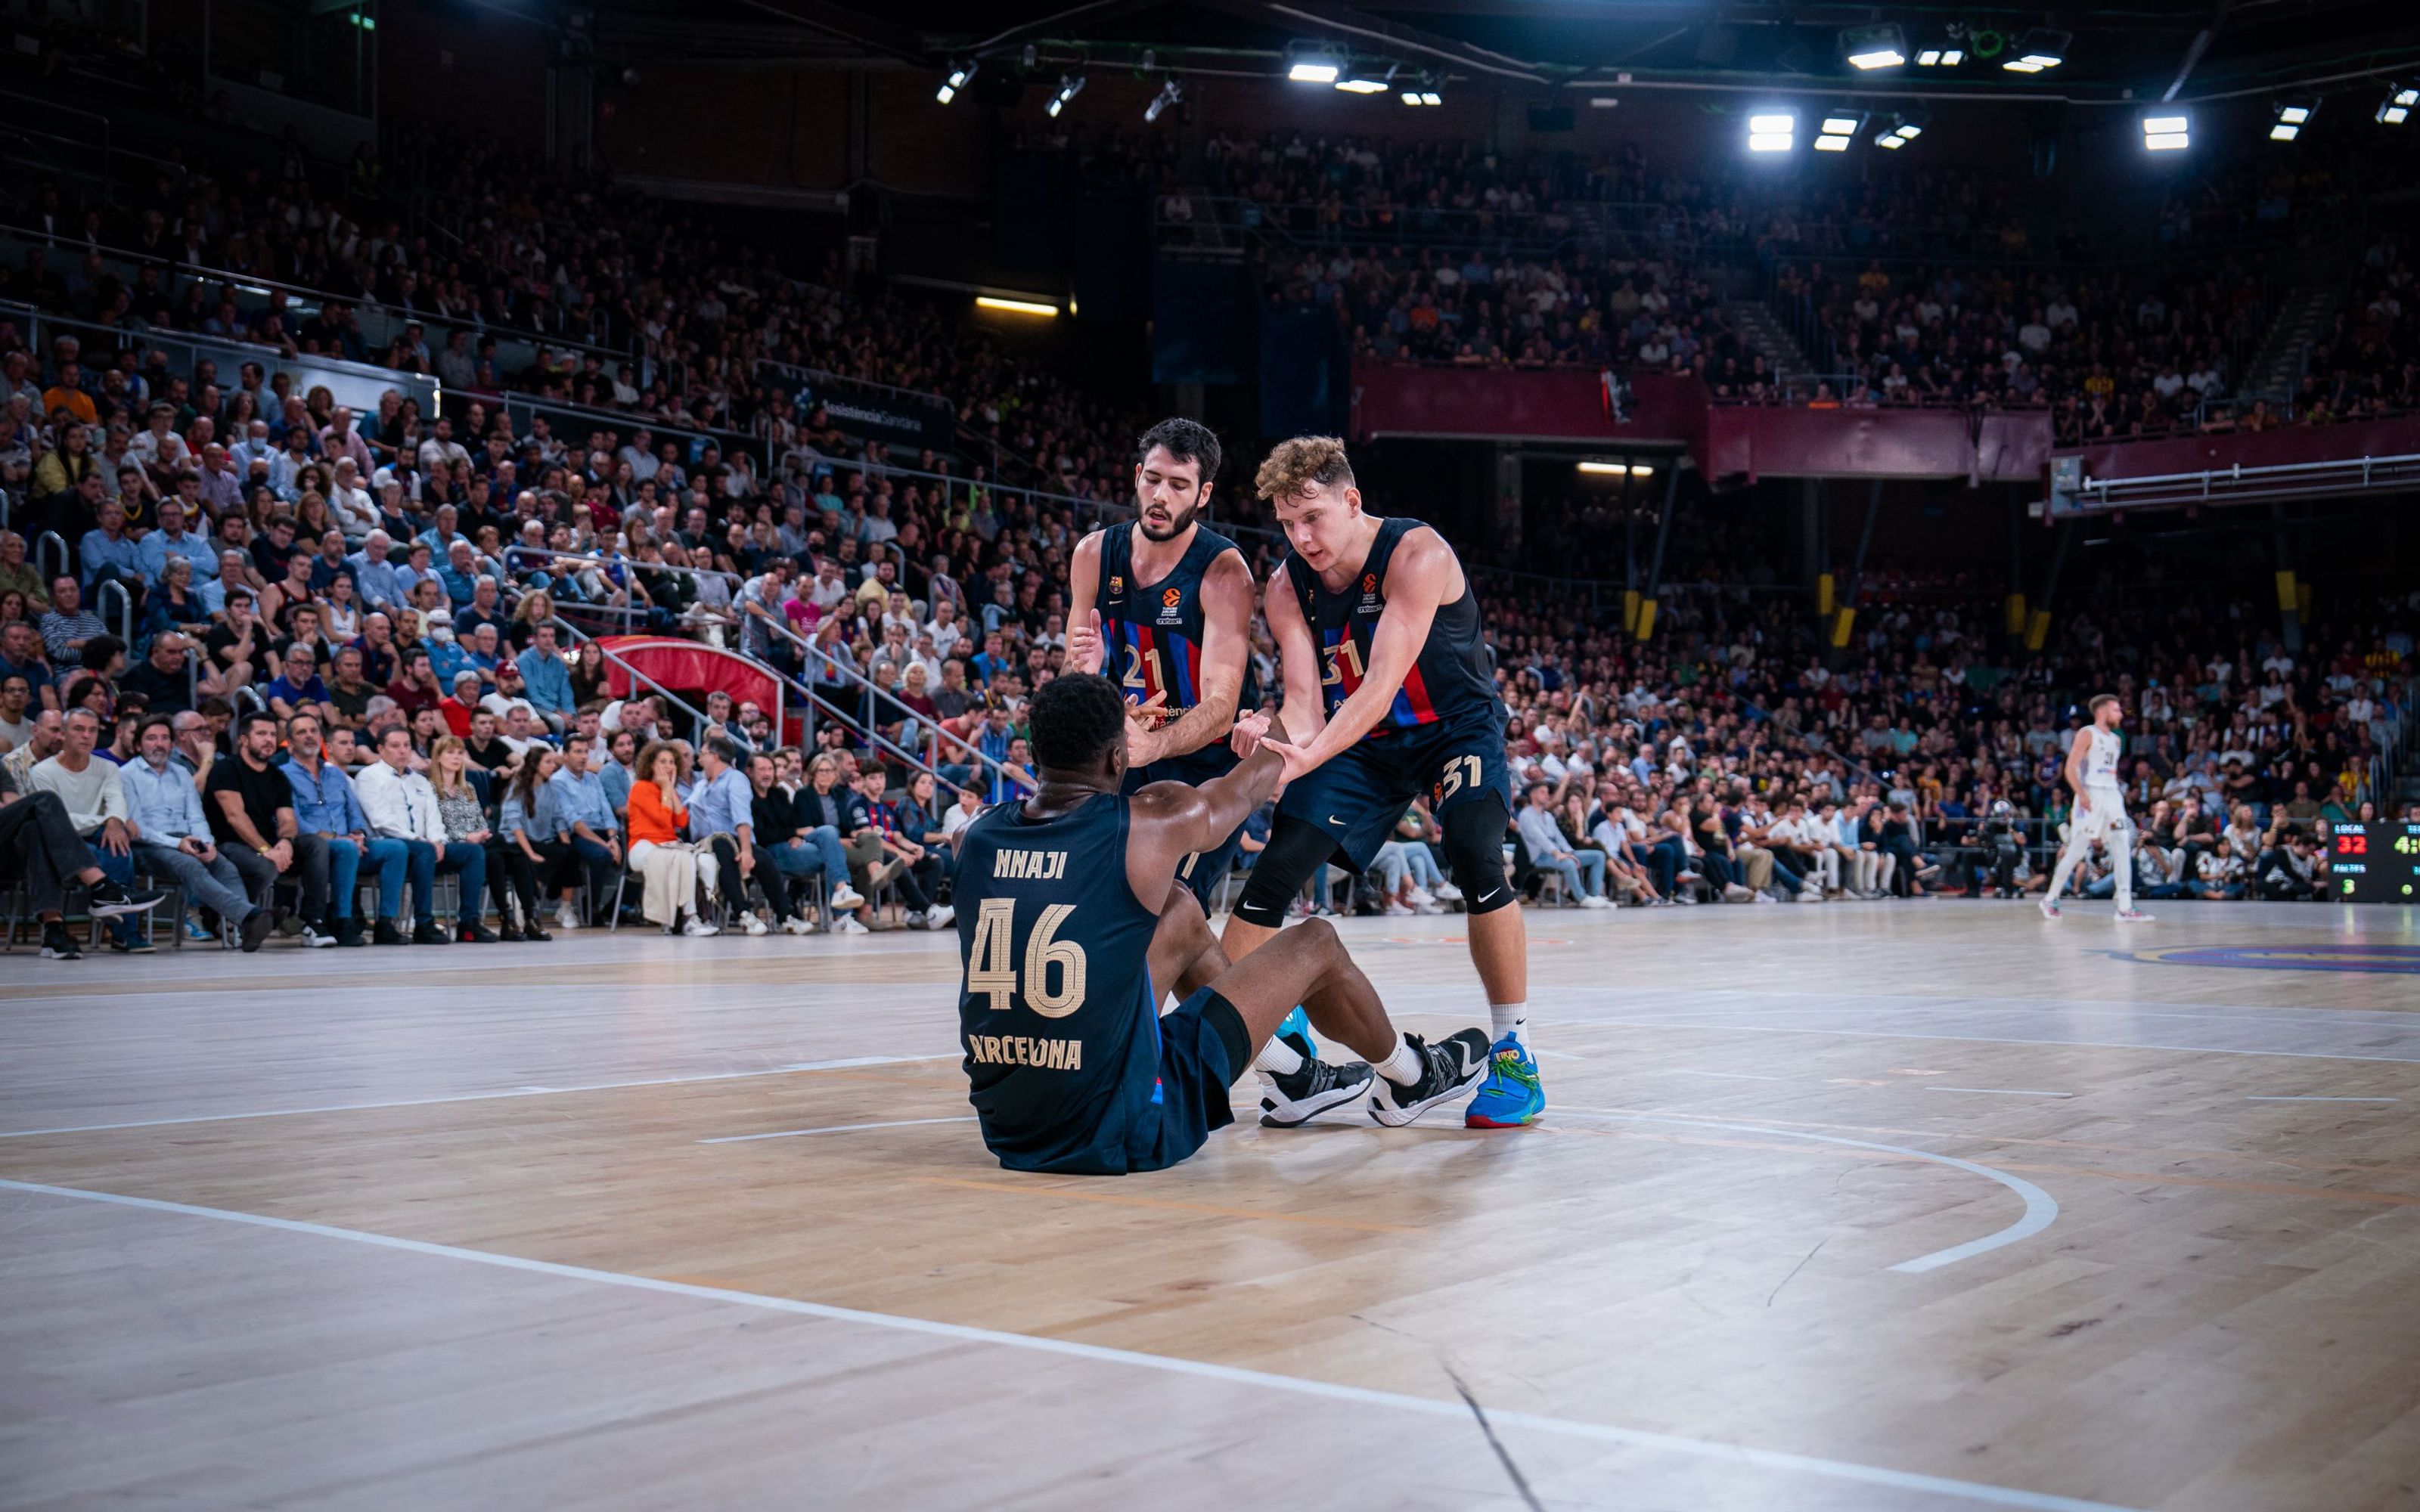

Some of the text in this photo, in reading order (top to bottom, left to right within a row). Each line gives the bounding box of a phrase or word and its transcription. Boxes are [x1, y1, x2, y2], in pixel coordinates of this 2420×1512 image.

[1123, 644, 1165, 690] 21
[1322, 640, 1364, 686] 31
[1443, 754, 1481, 799] 31
[993, 849, 1068, 879] NNAJI
[2338, 835, 2368, 854] 32
[967, 897, 1087, 1018] 46
